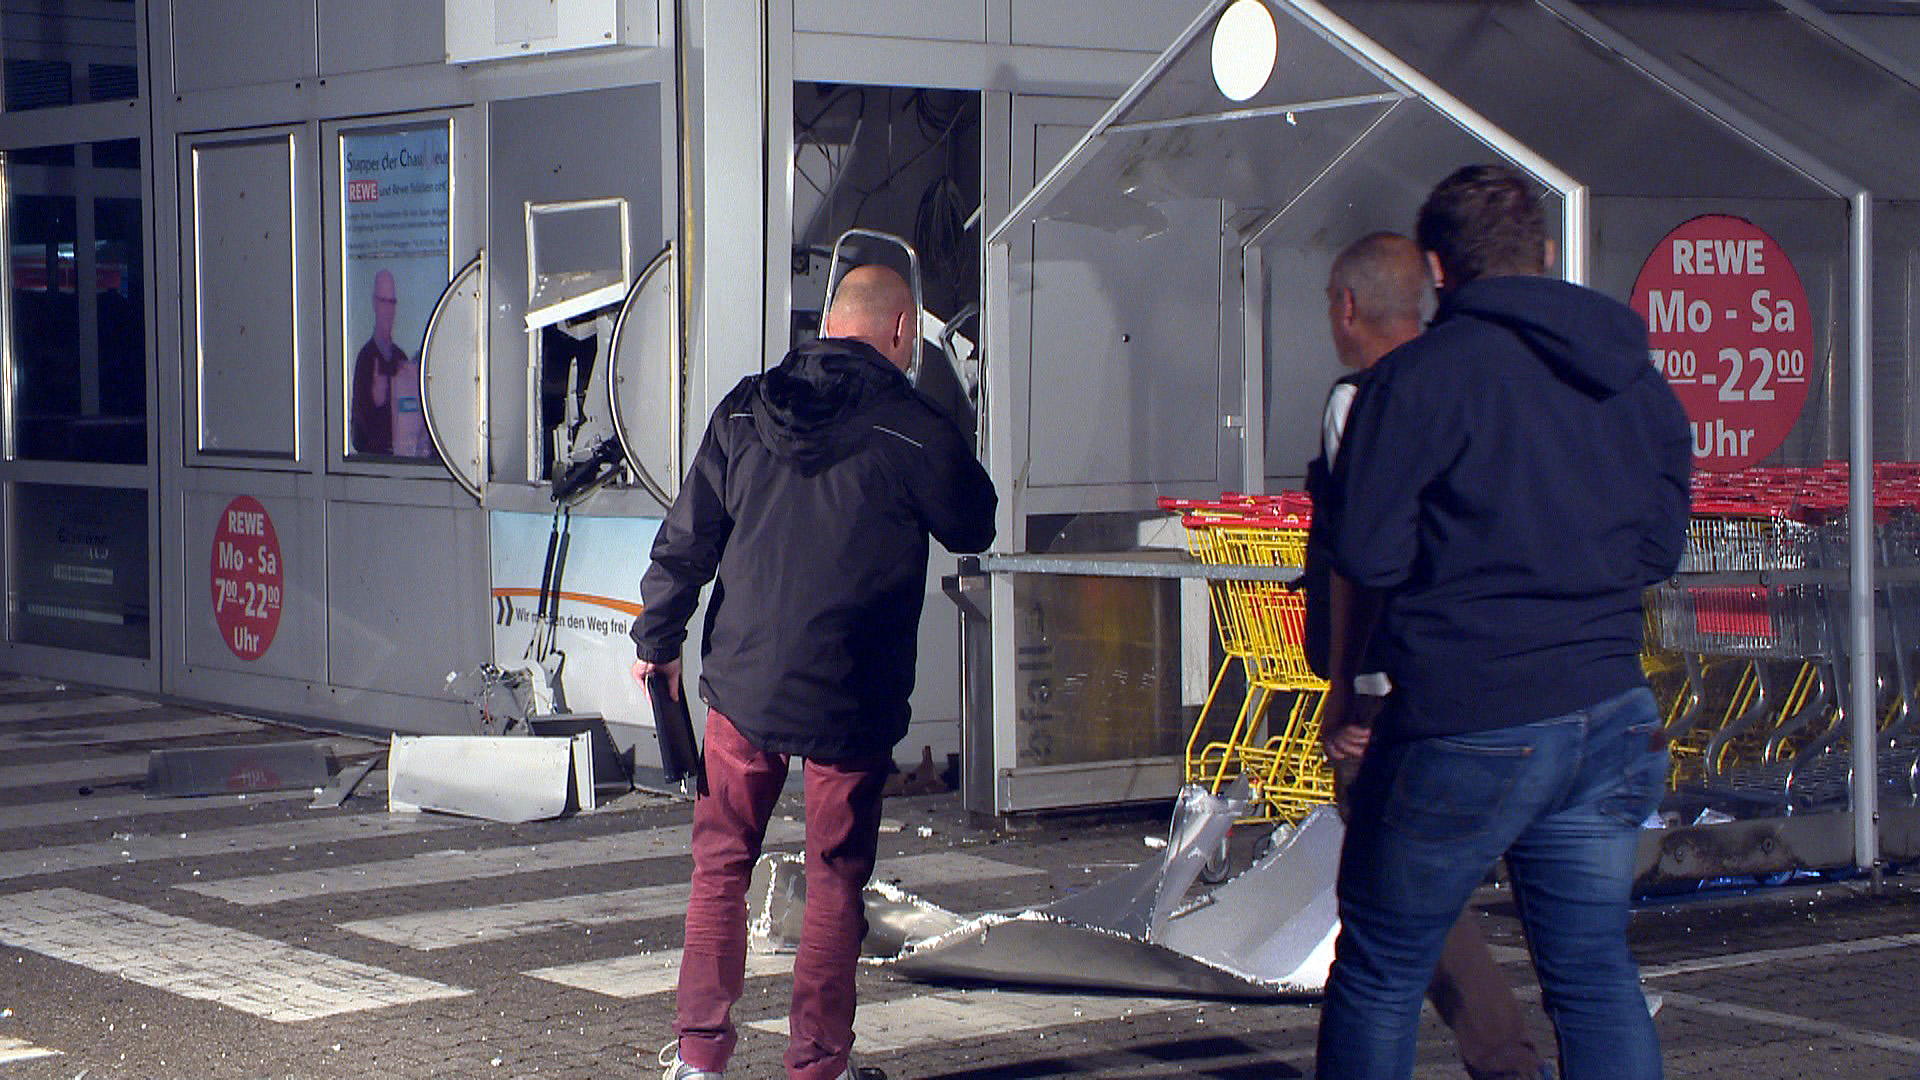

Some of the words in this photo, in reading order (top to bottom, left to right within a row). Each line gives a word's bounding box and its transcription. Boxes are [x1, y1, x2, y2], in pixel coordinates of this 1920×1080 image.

[382, 153, 397, 171] der
[349, 183, 377, 200] REWE
[1673, 240, 1765, 275] REWE
[1649, 290, 1712, 333] Mo
[1751, 289, 1795, 333] Sa
[1690, 419, 1754, 458] Uhr
[228, 510, 264, 536] REWE
[219, 542, 243, 571] Mo
[258, 546, 276, 576] Sa
[516, 607, 529, 622] Wir
[567, 614, 584, 629] den
[587, 616, 608, 636] Weg
[611, 618, 627, 634] frei
[234, 626, 259, 652] Uhr
